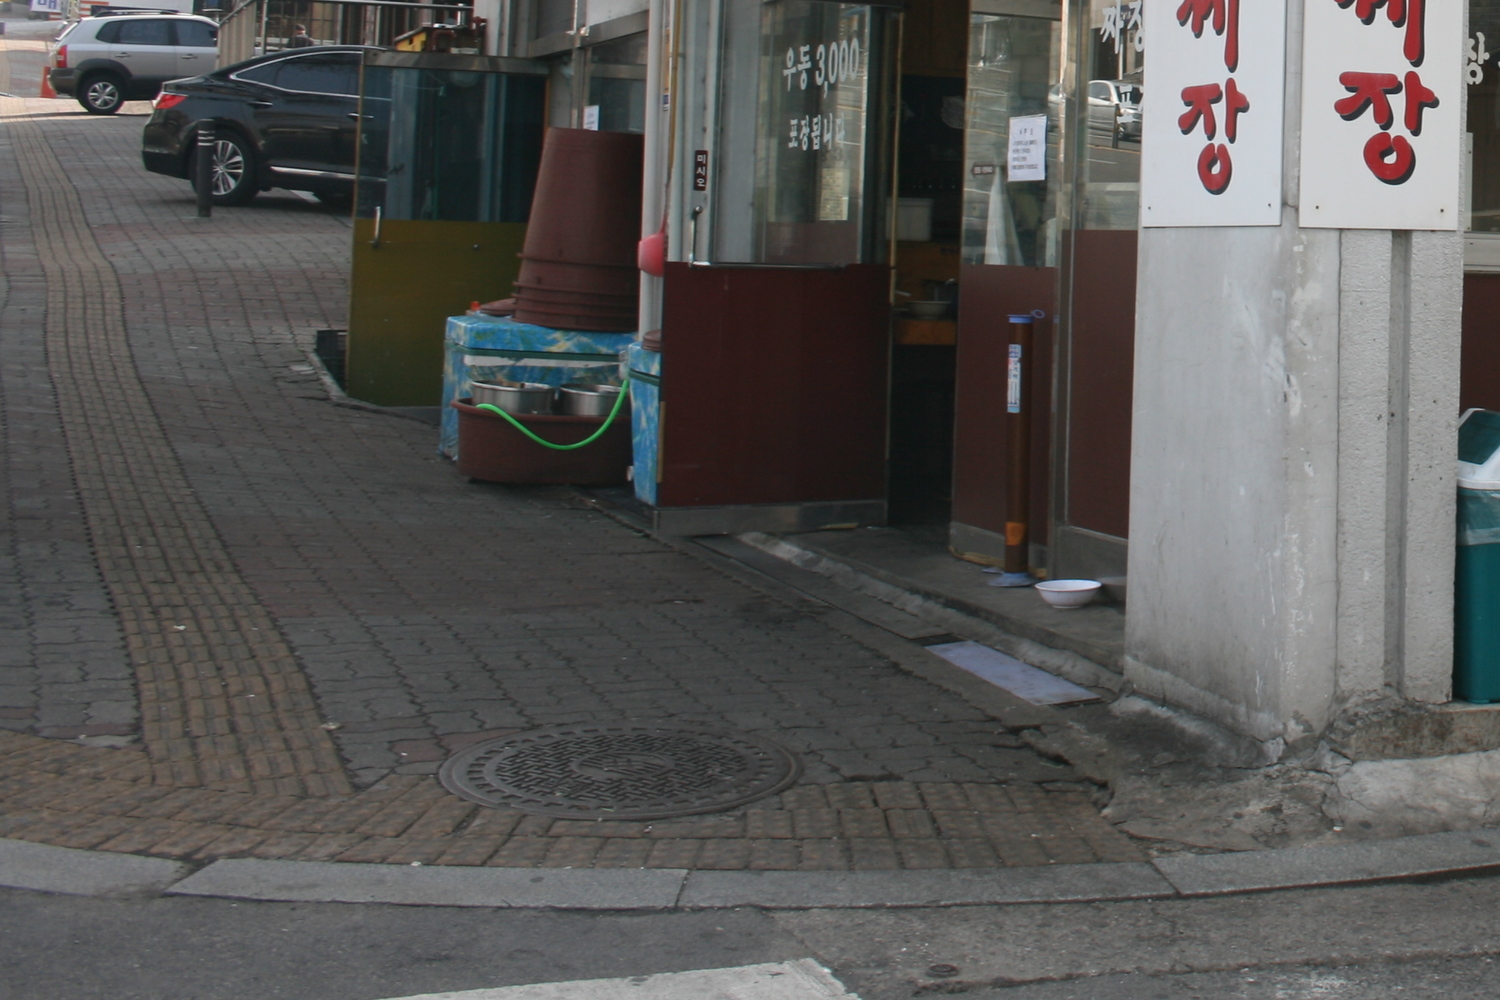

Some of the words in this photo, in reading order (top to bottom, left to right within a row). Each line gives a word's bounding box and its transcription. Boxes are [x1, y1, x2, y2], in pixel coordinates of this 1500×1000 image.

[782, 44, 812, 92] 우동
[815, 38, 860, 98] 3,000
[788, 112, 846, 151] 포장됩니다
[696, 154, 706, 187] 미시오
